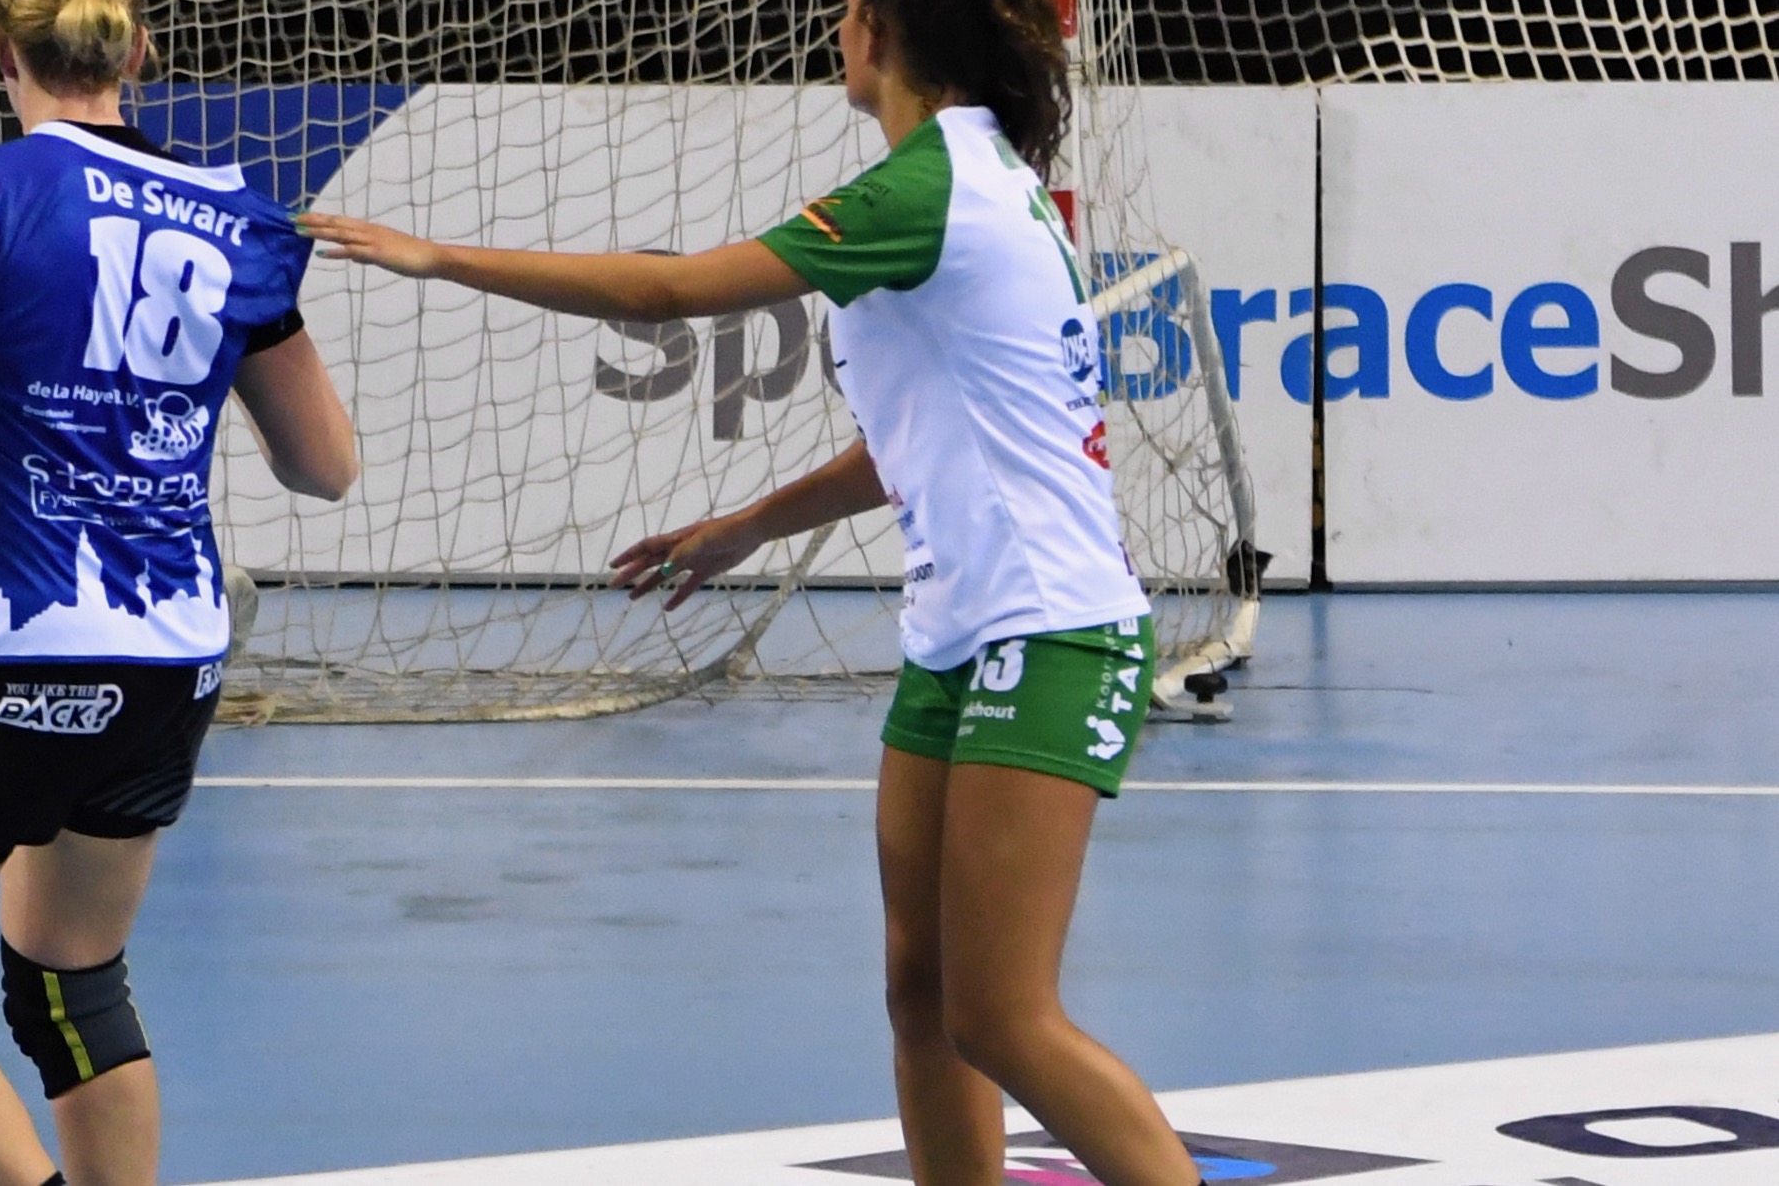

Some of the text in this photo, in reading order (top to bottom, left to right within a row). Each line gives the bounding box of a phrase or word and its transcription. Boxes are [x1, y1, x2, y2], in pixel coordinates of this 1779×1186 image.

[84, 167, 249, 246] De Swart
[83, 216, 232, 385] 18
[6, 683, 97, 696] YOU LIKE THE
